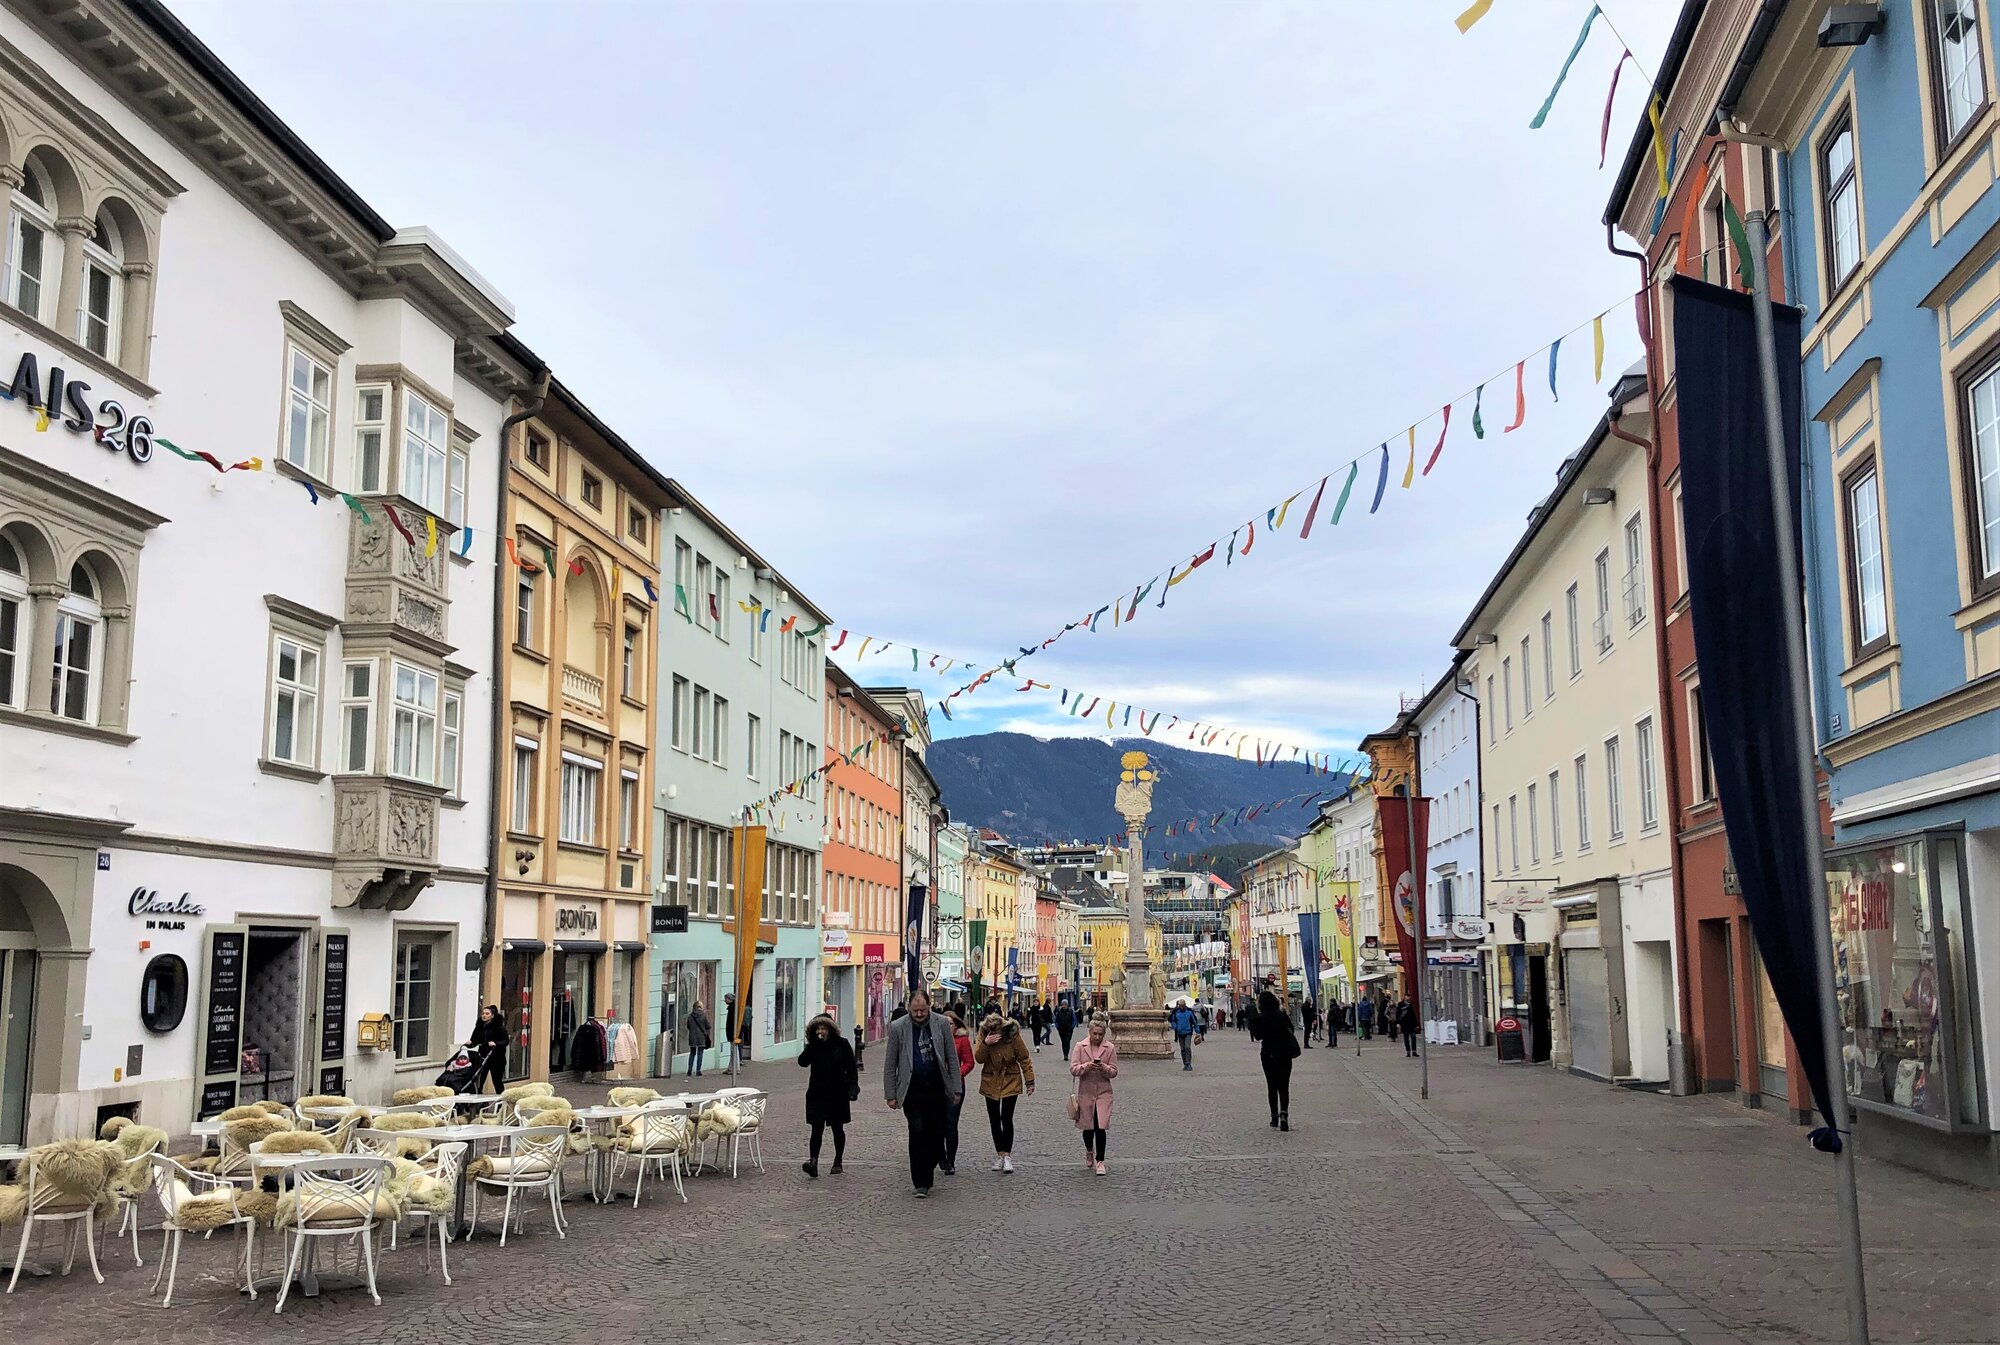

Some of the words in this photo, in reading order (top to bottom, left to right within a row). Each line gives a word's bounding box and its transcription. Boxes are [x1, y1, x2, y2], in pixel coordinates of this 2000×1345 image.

[100, 856, 109, 867] 26
[127, 886, 206, 916] Charles
[146, 920, 156, 929] IN
[158, 921, 186, 930] PALAIS
[655, 917, 683, 927] BONITA
